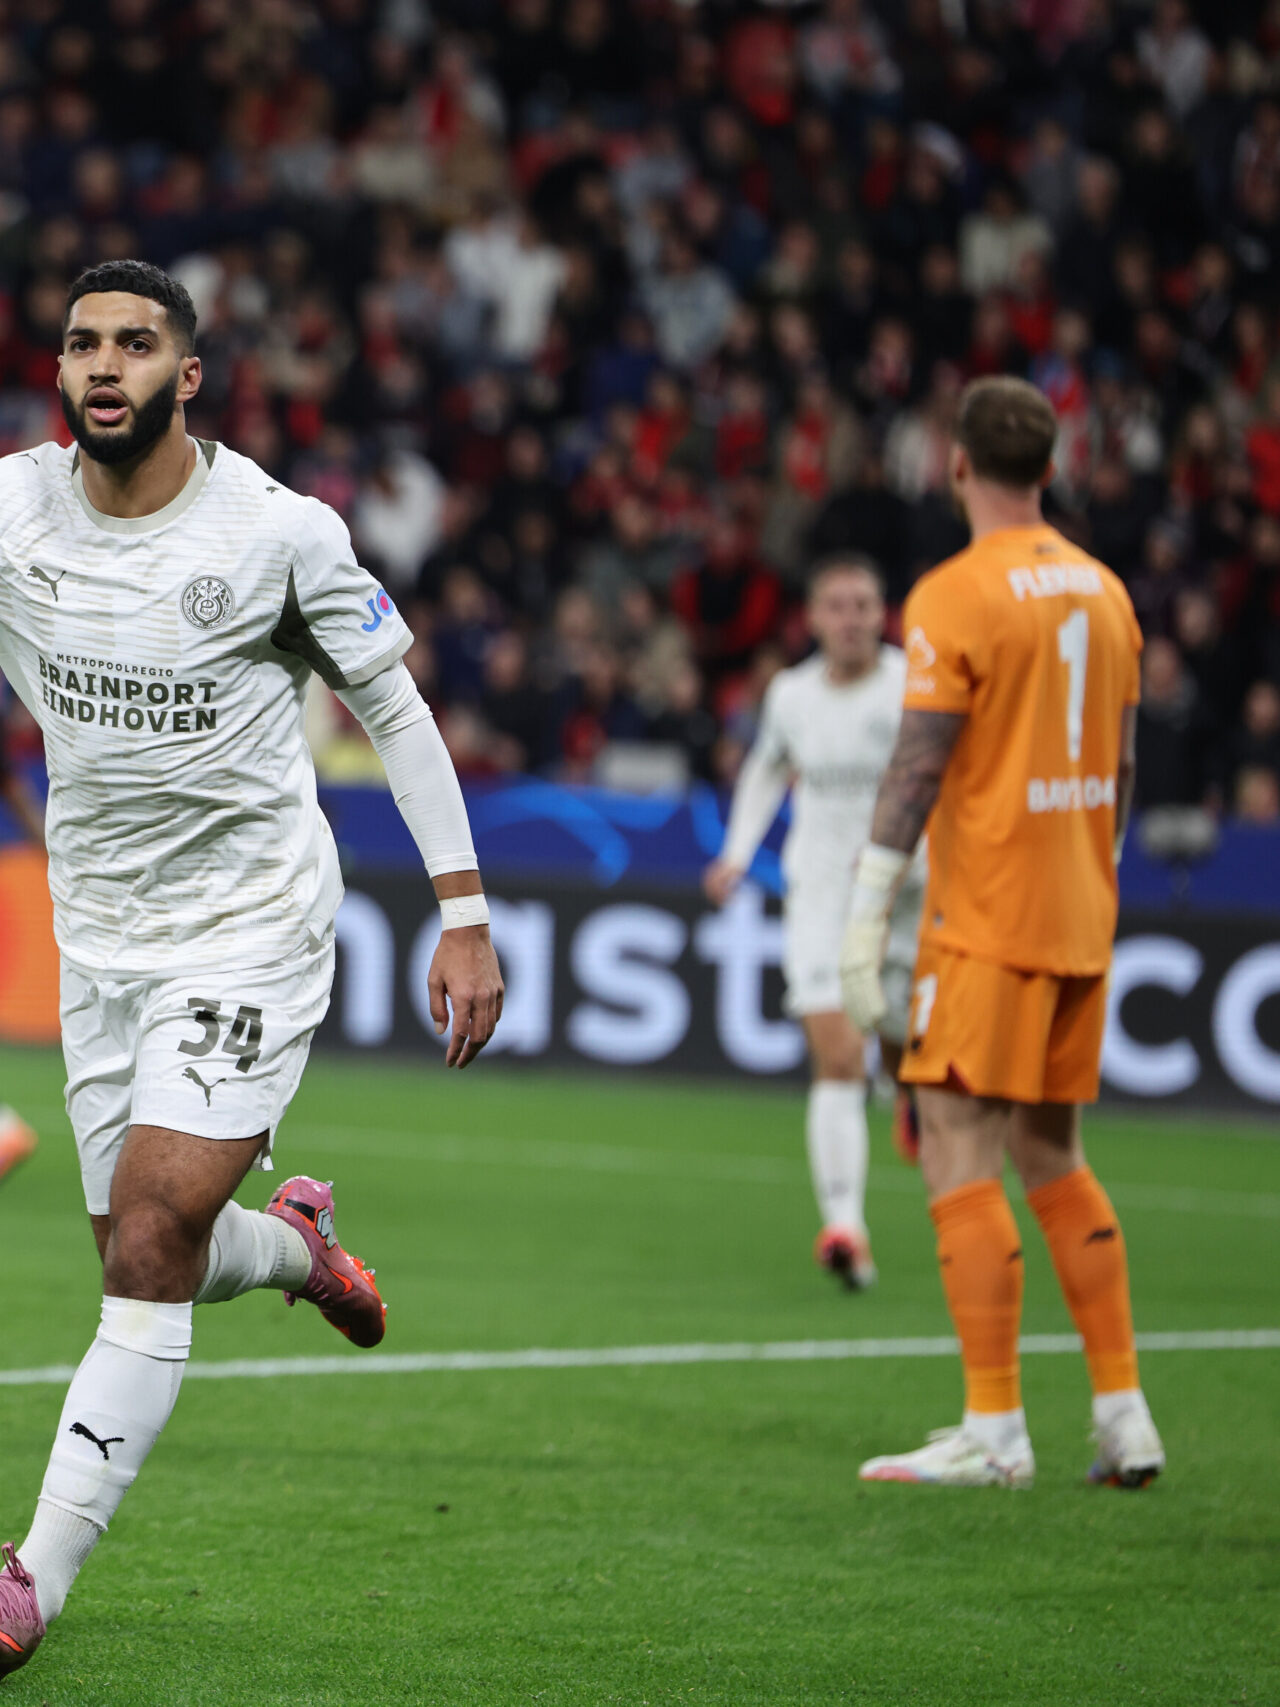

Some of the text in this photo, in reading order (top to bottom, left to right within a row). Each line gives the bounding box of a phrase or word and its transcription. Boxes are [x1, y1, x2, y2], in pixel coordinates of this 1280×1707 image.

[38, 654, 217, 705] BRAINPORT
[56, 653, 174, 677] METROPOOLREGIO
[1058, 608, 1089, 763] 1
[42, 682, 217, 733] EINDHOVEN
[177, 997, 263, 1074] 34
